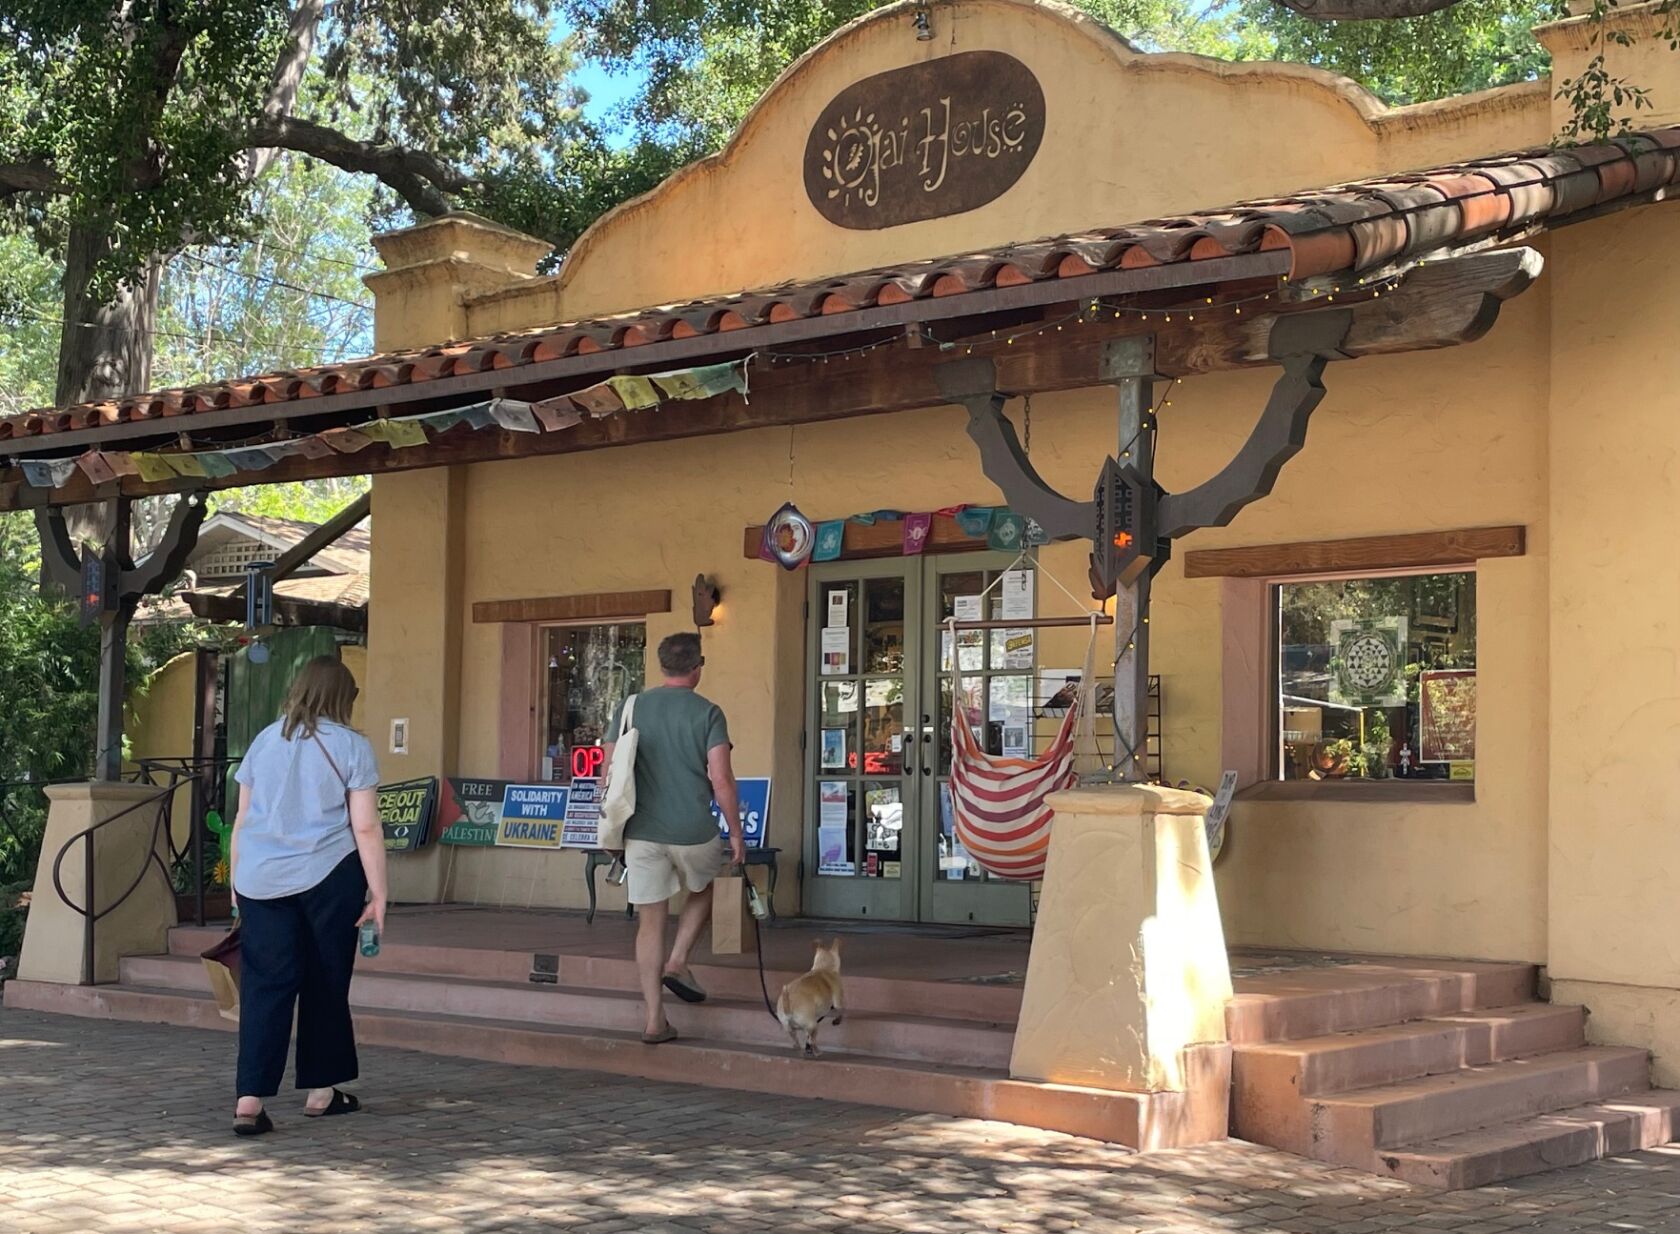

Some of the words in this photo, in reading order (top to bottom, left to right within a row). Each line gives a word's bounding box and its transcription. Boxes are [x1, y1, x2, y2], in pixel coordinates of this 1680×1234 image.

[831, 114, 909, 207] Ojai
[916, 96, 1026, 192] House
[461, 783, 493, 796] FREE
[511, 790, 563, 804] SOLIDARITY
[377, 793, 397, 809] CE
[397, 791, 425, 807] OUT
[390, 807, 420, 822] OJAI
[521, 803, 547, 816] WITH
[504, 822, 558, 841] UKRAINE
